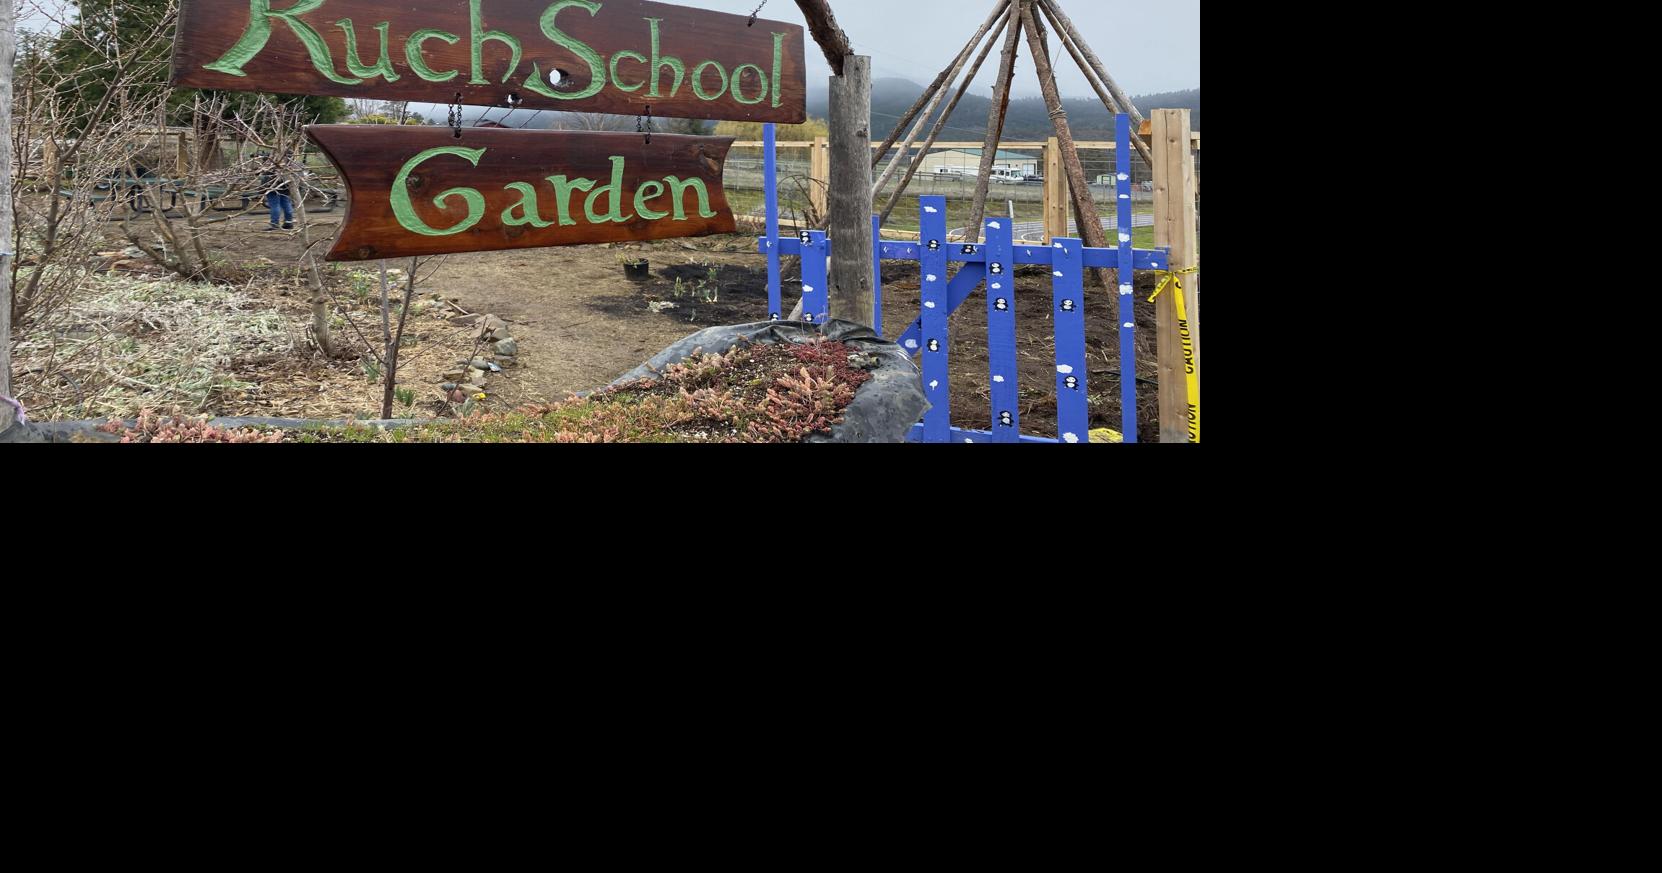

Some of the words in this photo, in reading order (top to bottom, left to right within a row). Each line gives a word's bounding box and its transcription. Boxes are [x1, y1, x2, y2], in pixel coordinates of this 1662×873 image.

[203, 0, 521, 86] Ruch
[523, 0, 787, 108] School
[390, 146, 717, 237] Garden
[1179, 319, 1195, 374] CAUTION
